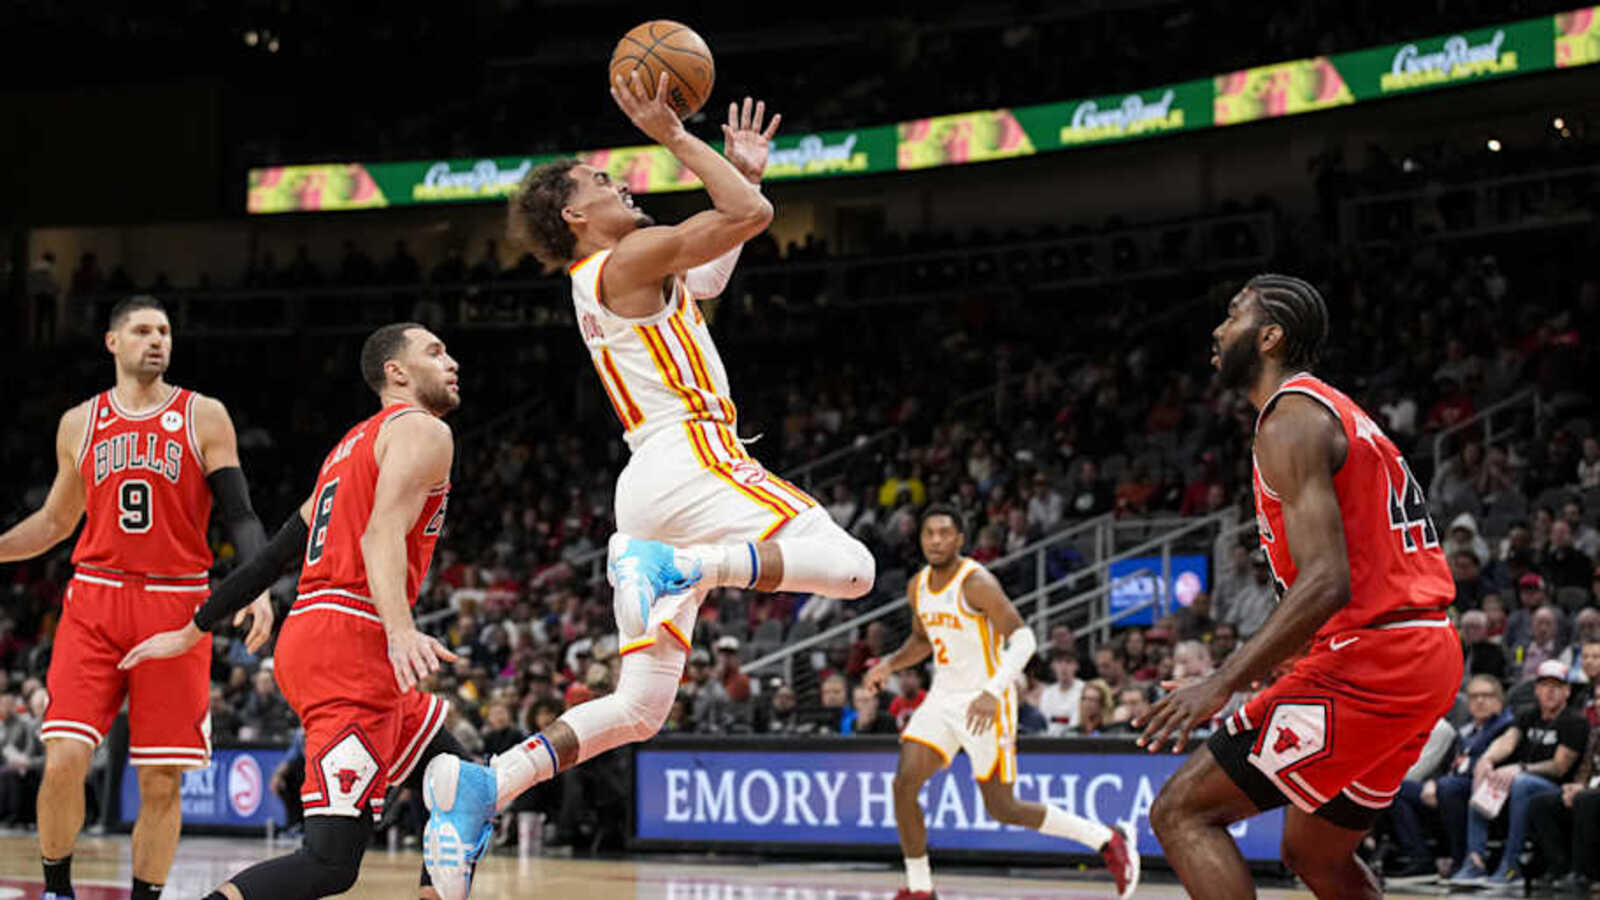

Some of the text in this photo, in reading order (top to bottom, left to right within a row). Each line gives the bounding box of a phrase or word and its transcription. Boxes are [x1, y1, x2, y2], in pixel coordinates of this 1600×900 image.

[93, 432, 183, 487] BULLS
[119, 478, 153, 534] 9
[306, 476, 341, 567] 8
[933, 637, 950, 666] 2
[664, 768, 848, 827] EMORY
